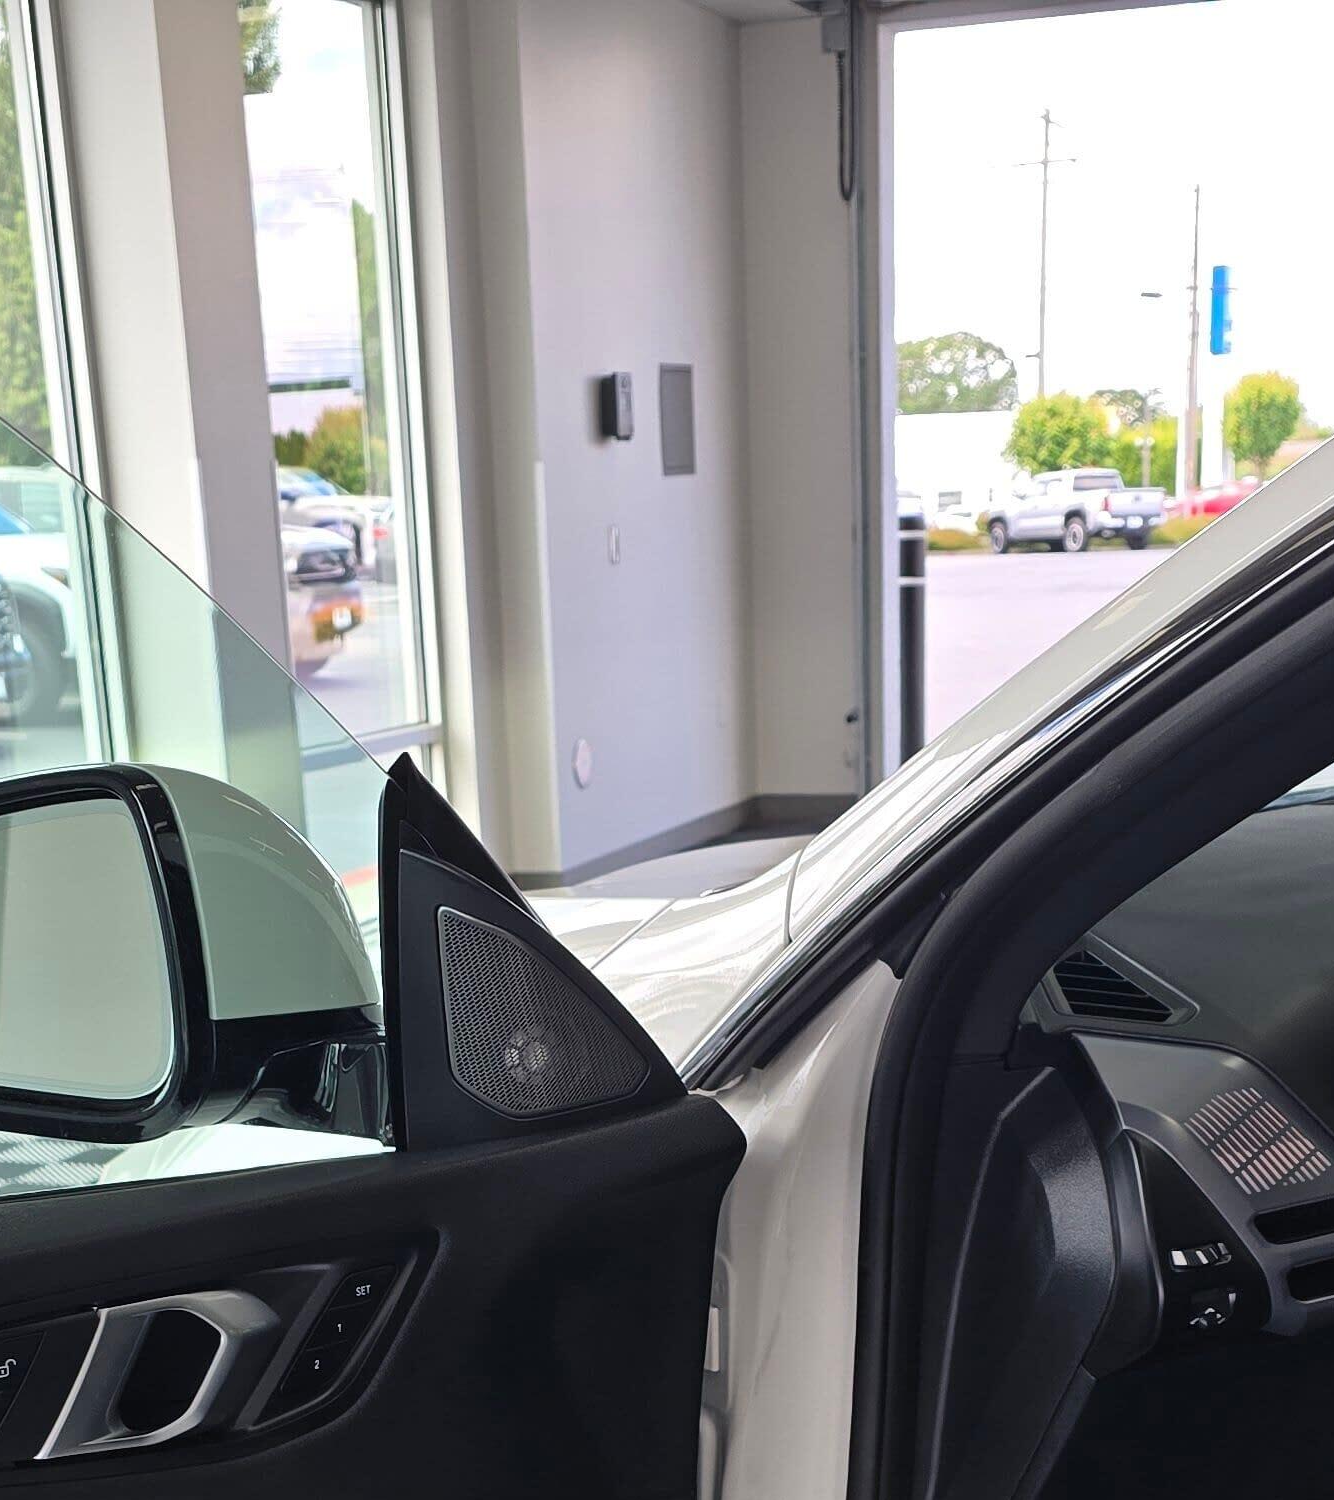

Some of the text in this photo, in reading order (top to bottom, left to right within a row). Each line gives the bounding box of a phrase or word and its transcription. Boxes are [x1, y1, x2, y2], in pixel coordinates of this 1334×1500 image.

[355, 1284, 371, 1297] SET
[337, 1323, 342, 1333] 1
[314, 1359, 320, 1370] 2
